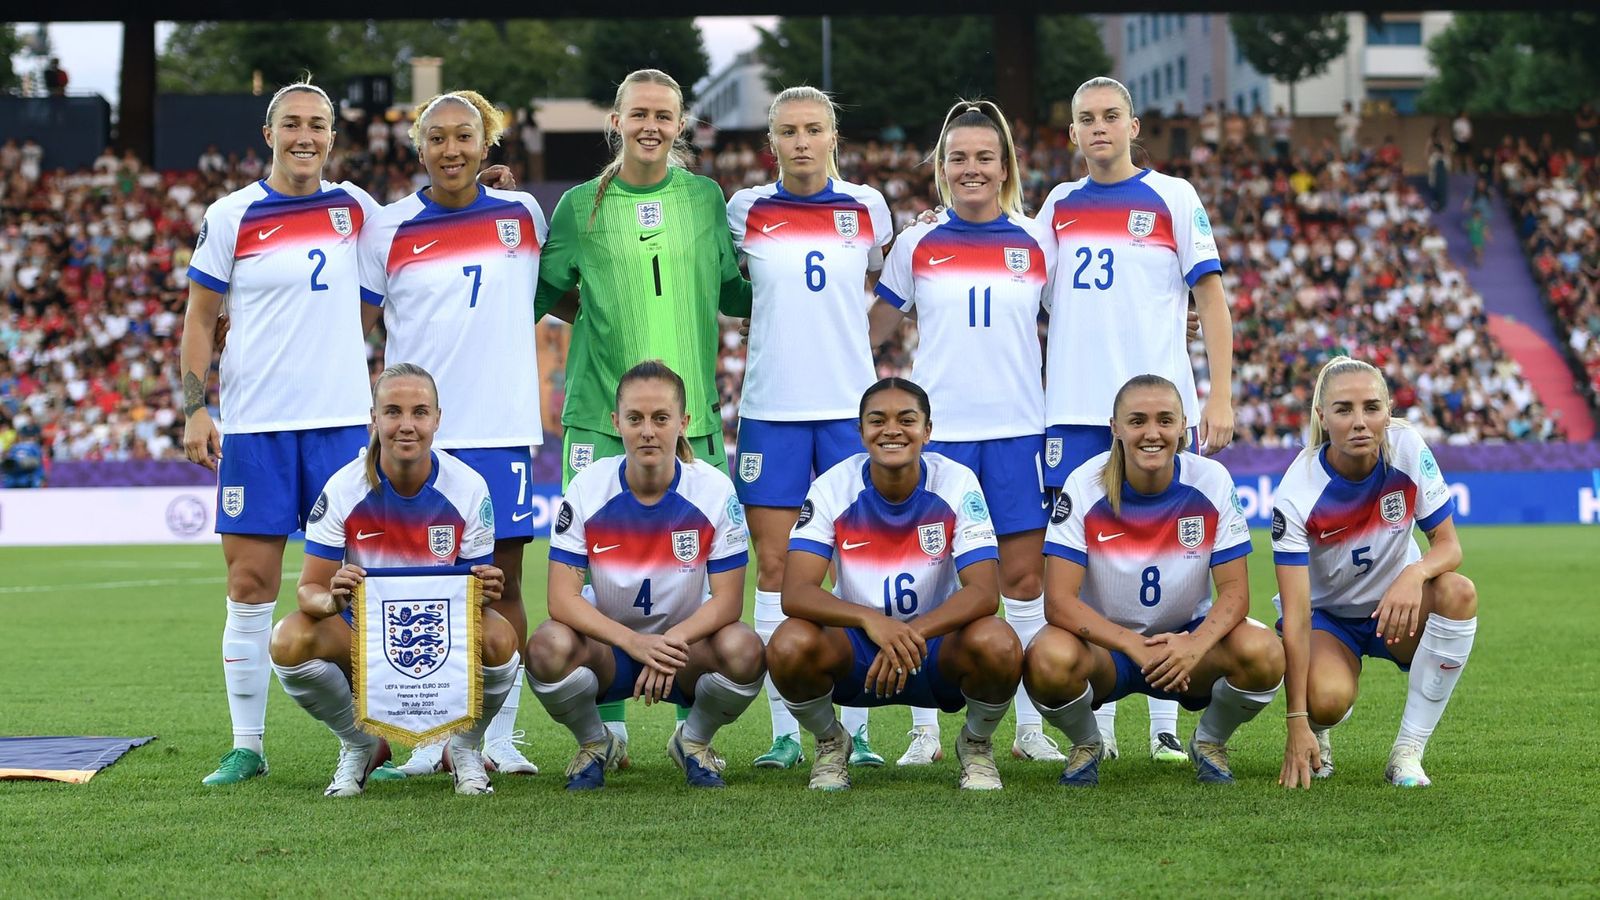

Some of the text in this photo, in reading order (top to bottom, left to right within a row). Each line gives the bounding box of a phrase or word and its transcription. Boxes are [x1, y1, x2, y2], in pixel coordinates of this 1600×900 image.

[307, 248, 329, 291] 2
[462, 264, 482, 308] 7
[652, 254, 662, 296] 1
[805, 250, 826, 292] 6
[1073, 247, 1114, 290] 23
[969, 286, 991, 327] 11
[511, 462, 527, 505] 7
[1351, 546, 1374, 577] 5
[633, 578, 654, 616] 4
[883, 572, 918, 617] 16
[1139, 565, 1161, 607] 8
